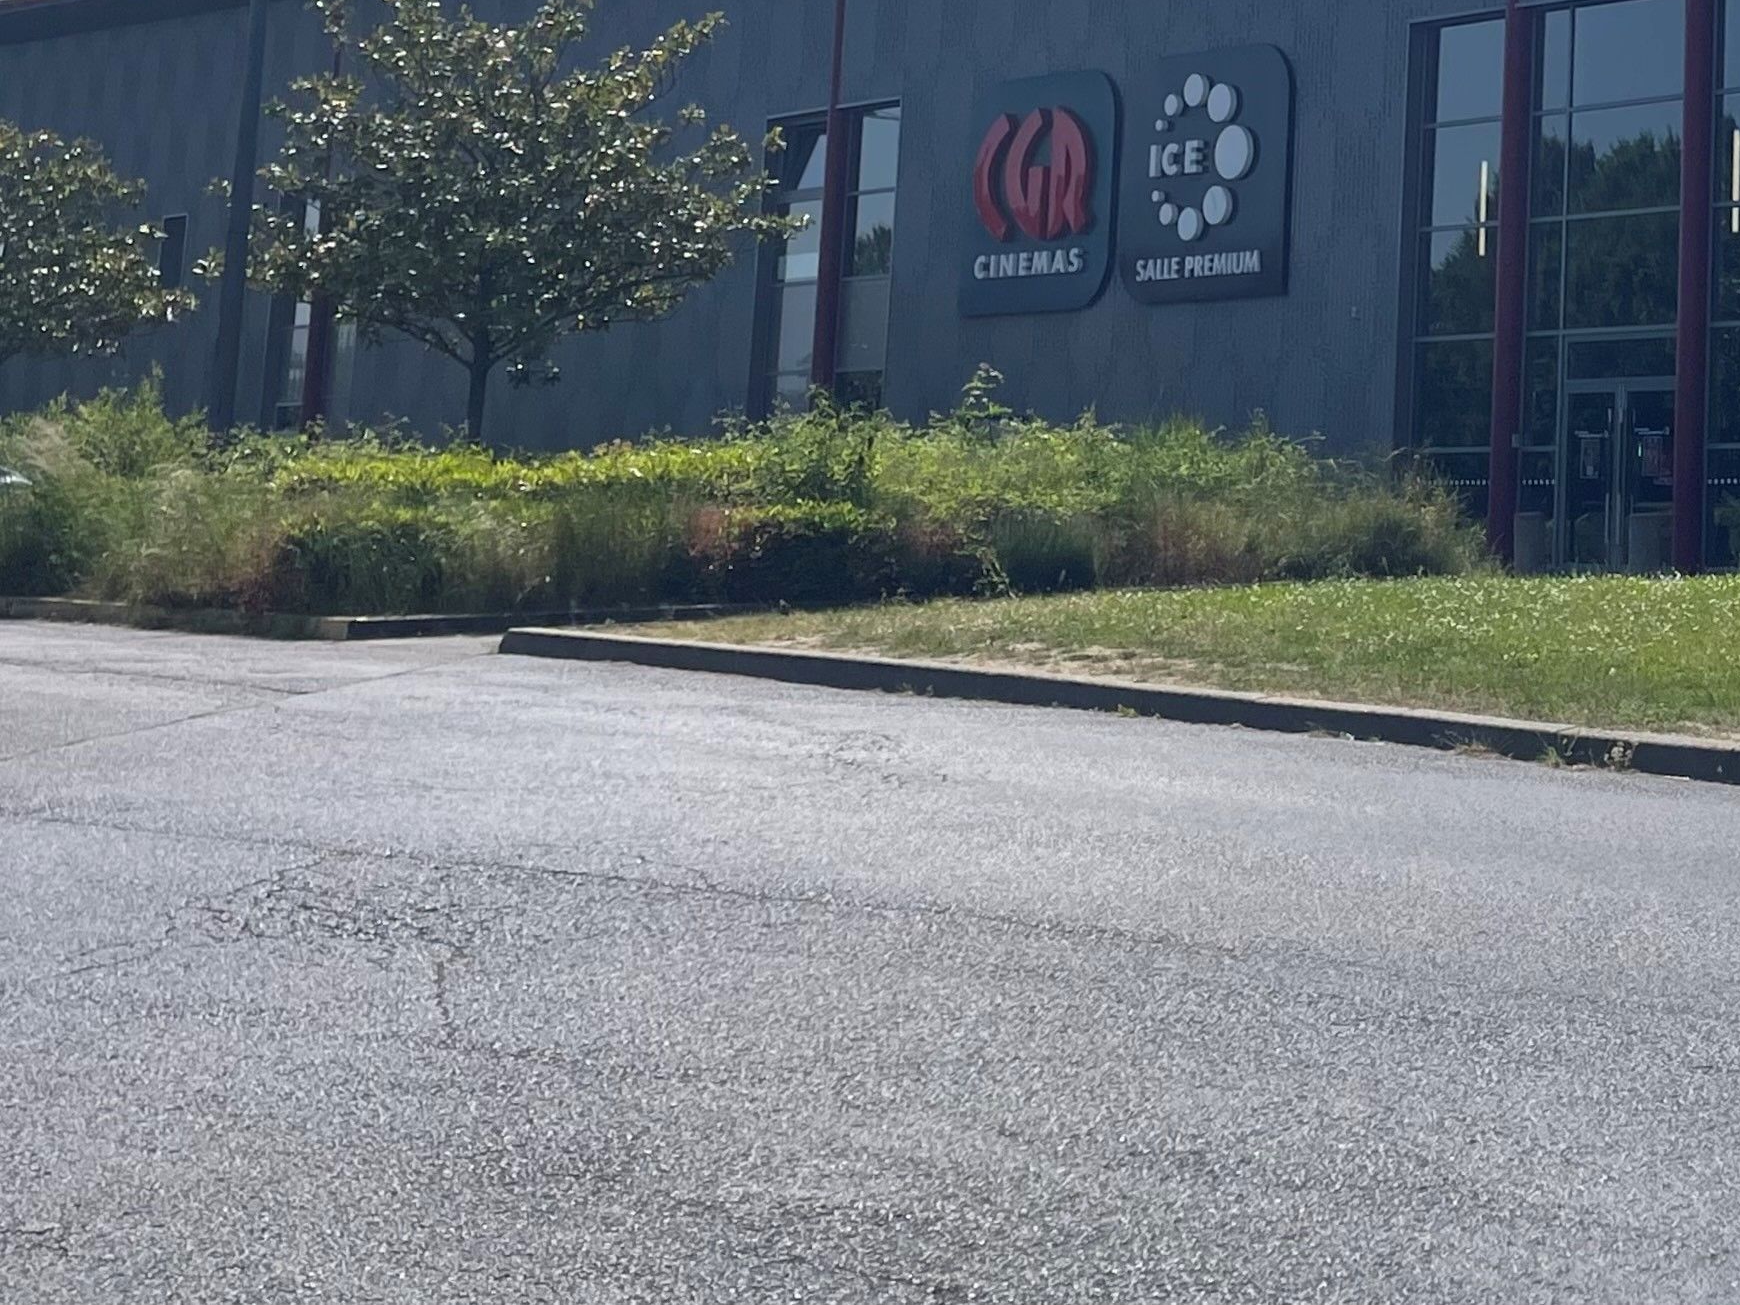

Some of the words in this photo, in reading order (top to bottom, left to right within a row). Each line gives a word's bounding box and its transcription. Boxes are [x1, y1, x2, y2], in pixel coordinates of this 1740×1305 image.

[973, 105, 1094, 241] CGR
[1148, 139, 1207, 178] ICE
[973, 247, 1085, 279] CINEMAS
[1135, 255, 1181, 282] SALLE
[1184, 250, 1261, 278] PREMIUM
